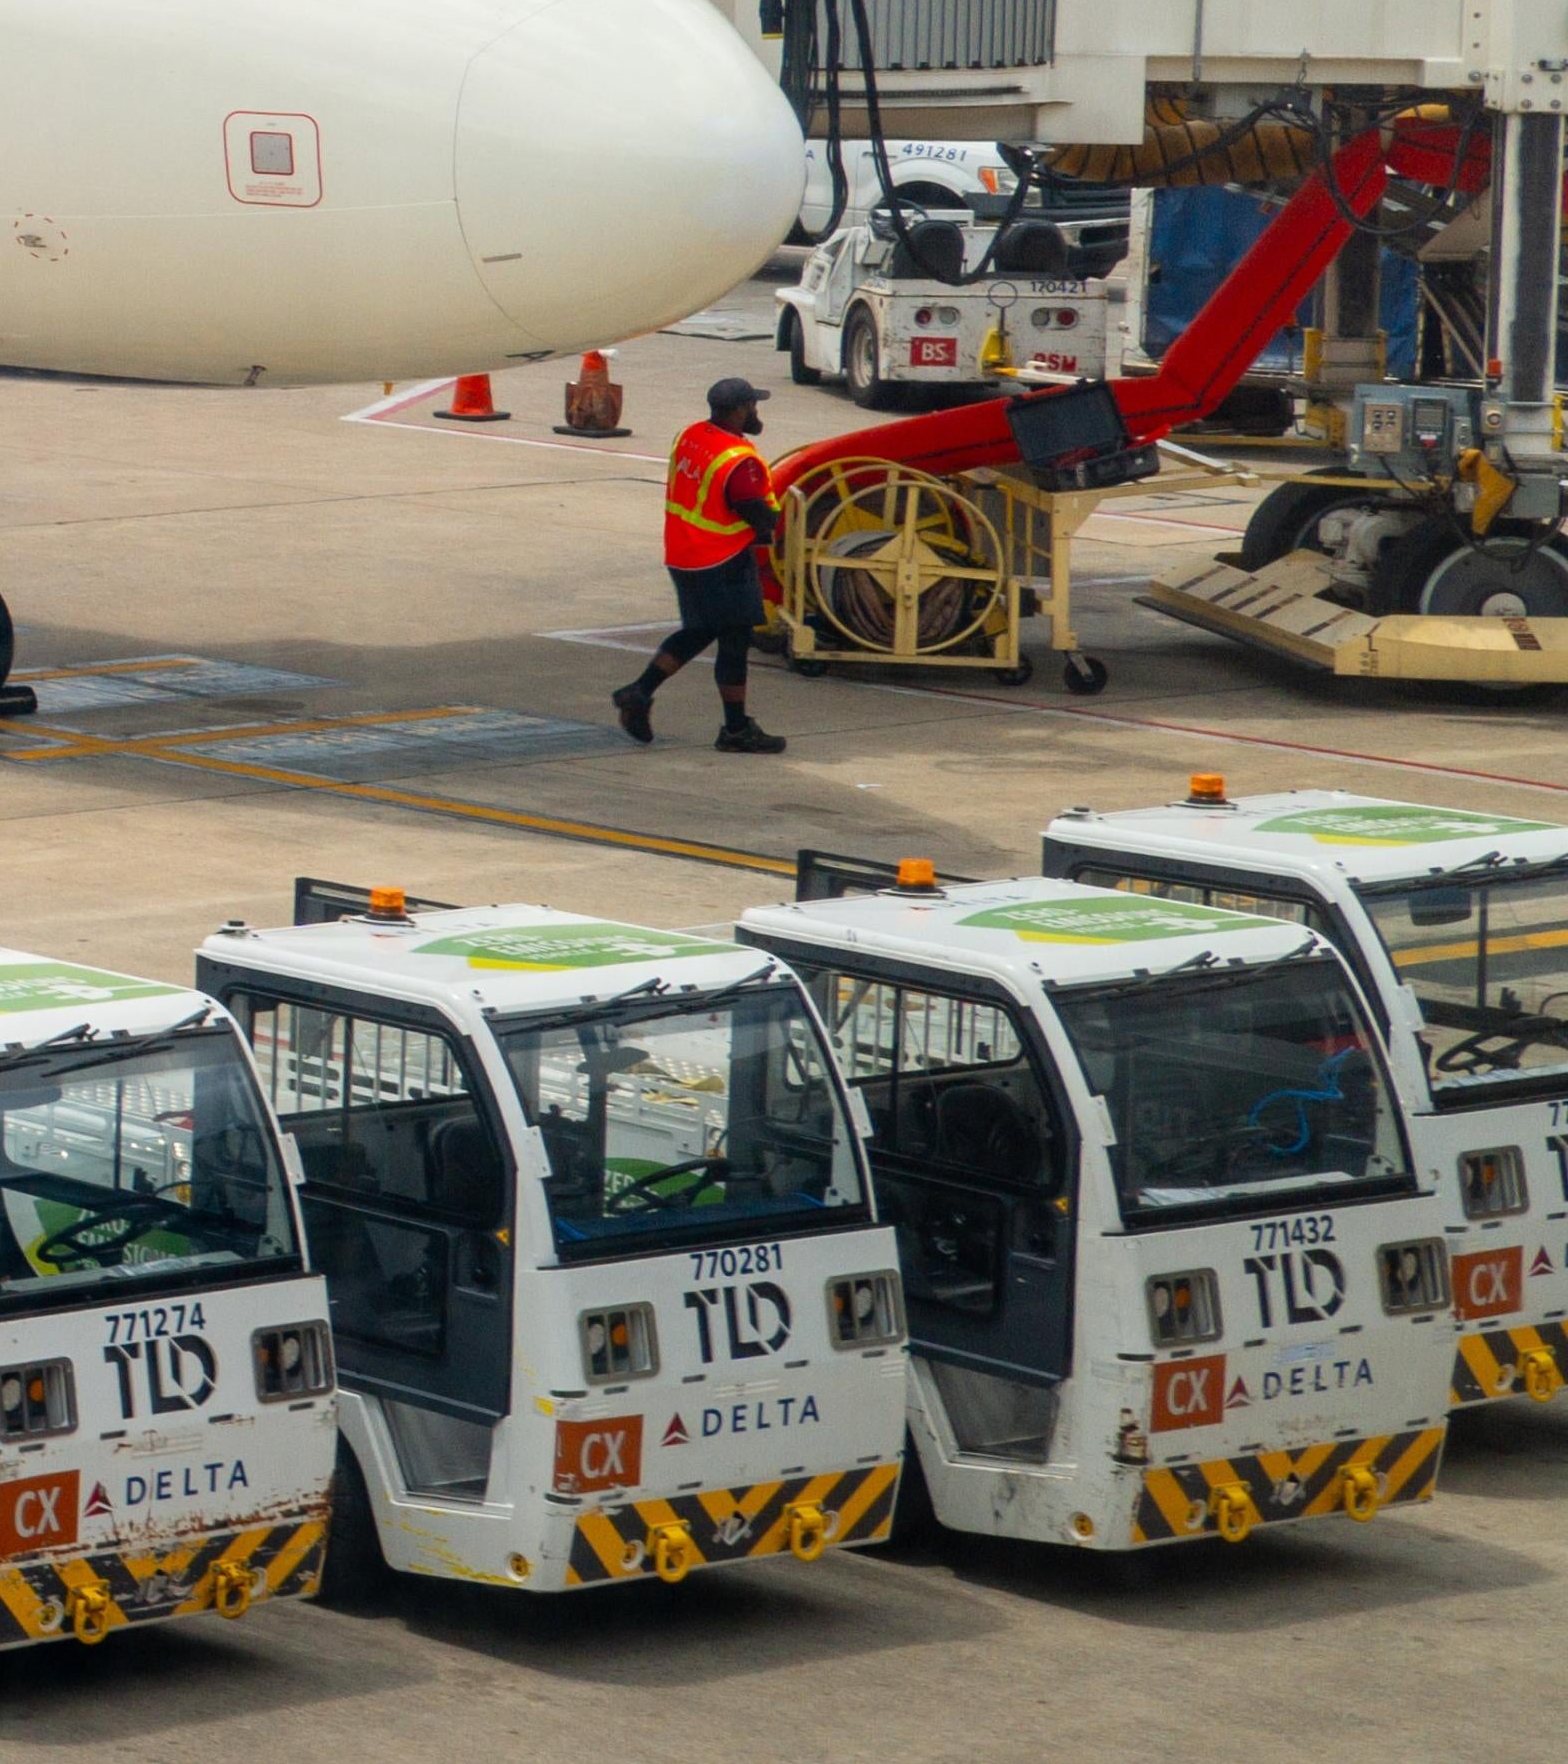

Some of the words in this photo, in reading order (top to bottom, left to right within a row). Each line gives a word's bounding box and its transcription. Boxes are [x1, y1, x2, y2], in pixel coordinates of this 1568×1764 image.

[902, 143, 967, 161] 491281
[922, 341, 947, 361] BS
[1250, 1215, 1335, 1251] 771432
[689, 1243, 783, 1281] 770281
[1469, 1262, 1508, 1306] CX
[1243, 1248, 1346, 1328] TLD
[106, 1302, 206, 1342] 771274
[683, 1280, 791, 1364] TLD
[104, 1334, 217, 1420] TLD
[1165, 1369, 1209, 1414] CX
[1263, 1358, 1373, 1401] DELTA
[702, 1396, 821, 1438] DELTA
[579, 1428, 625, 1476] CX
[125, 1459, 249, 1507] DELTA
[13, 1488, 61, 1538] CX
